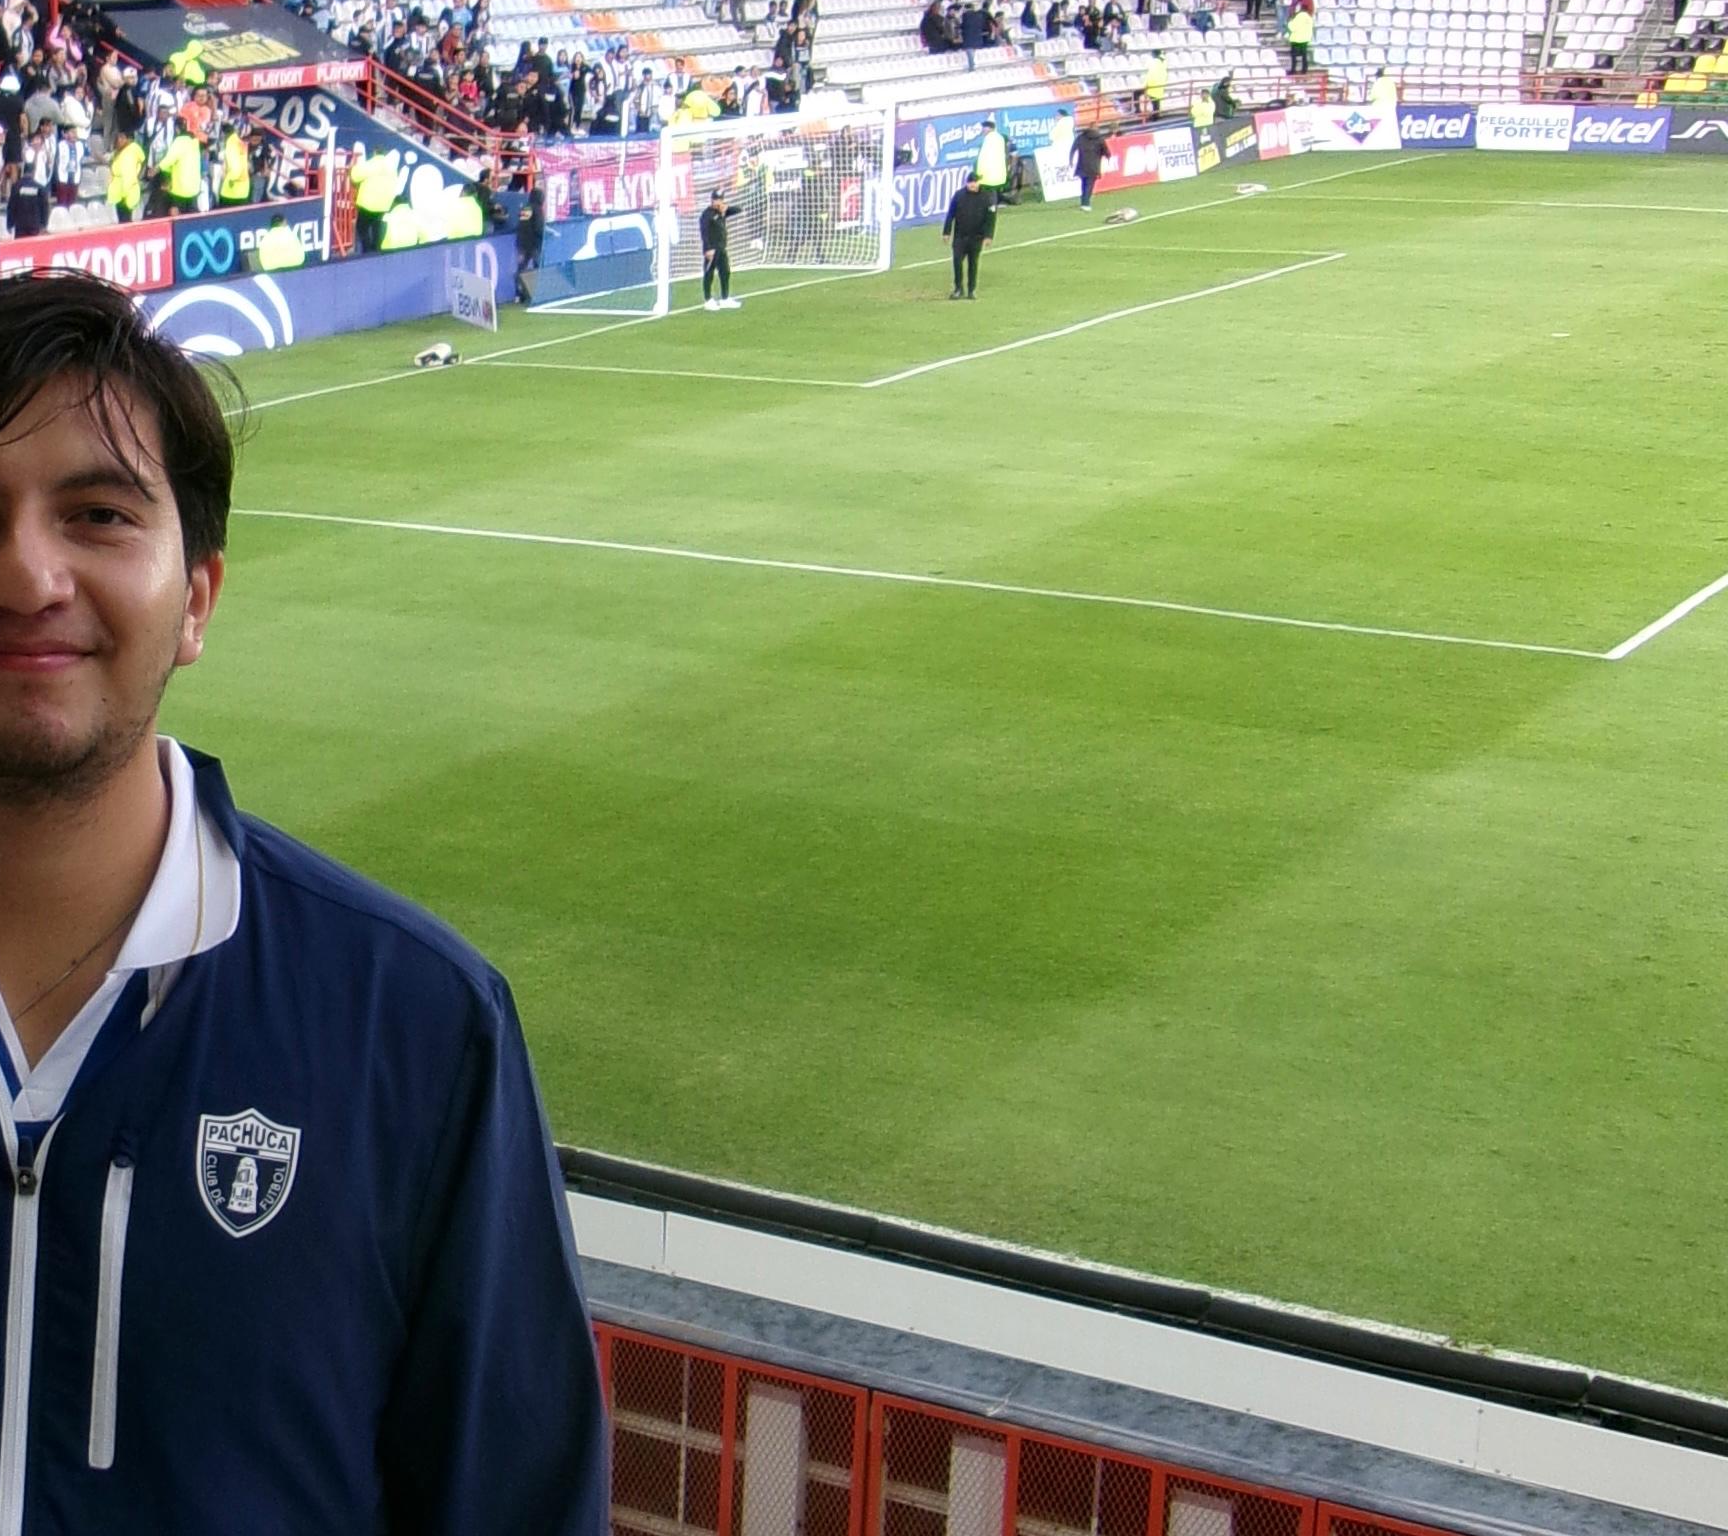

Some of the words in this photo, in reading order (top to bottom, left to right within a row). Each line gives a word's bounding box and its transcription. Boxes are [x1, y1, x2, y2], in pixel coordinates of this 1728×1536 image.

[252, 70, 303, 89] PLAYDOIT
[1400, 113, 1471, 140] telcel
[1479, 115, 1570, 127] PEGAZULEJO
[1493, 126, 1568, 140] FORTEC
[1572, 116, 1666, 144] telcel
[582, 166, 689, 215] PLAYDIT
[208, 1122, 289, 1151] PACHUCA
[206, 1154, 219, 1187] CLUB
[211, 1188, 226, 1206] DE
